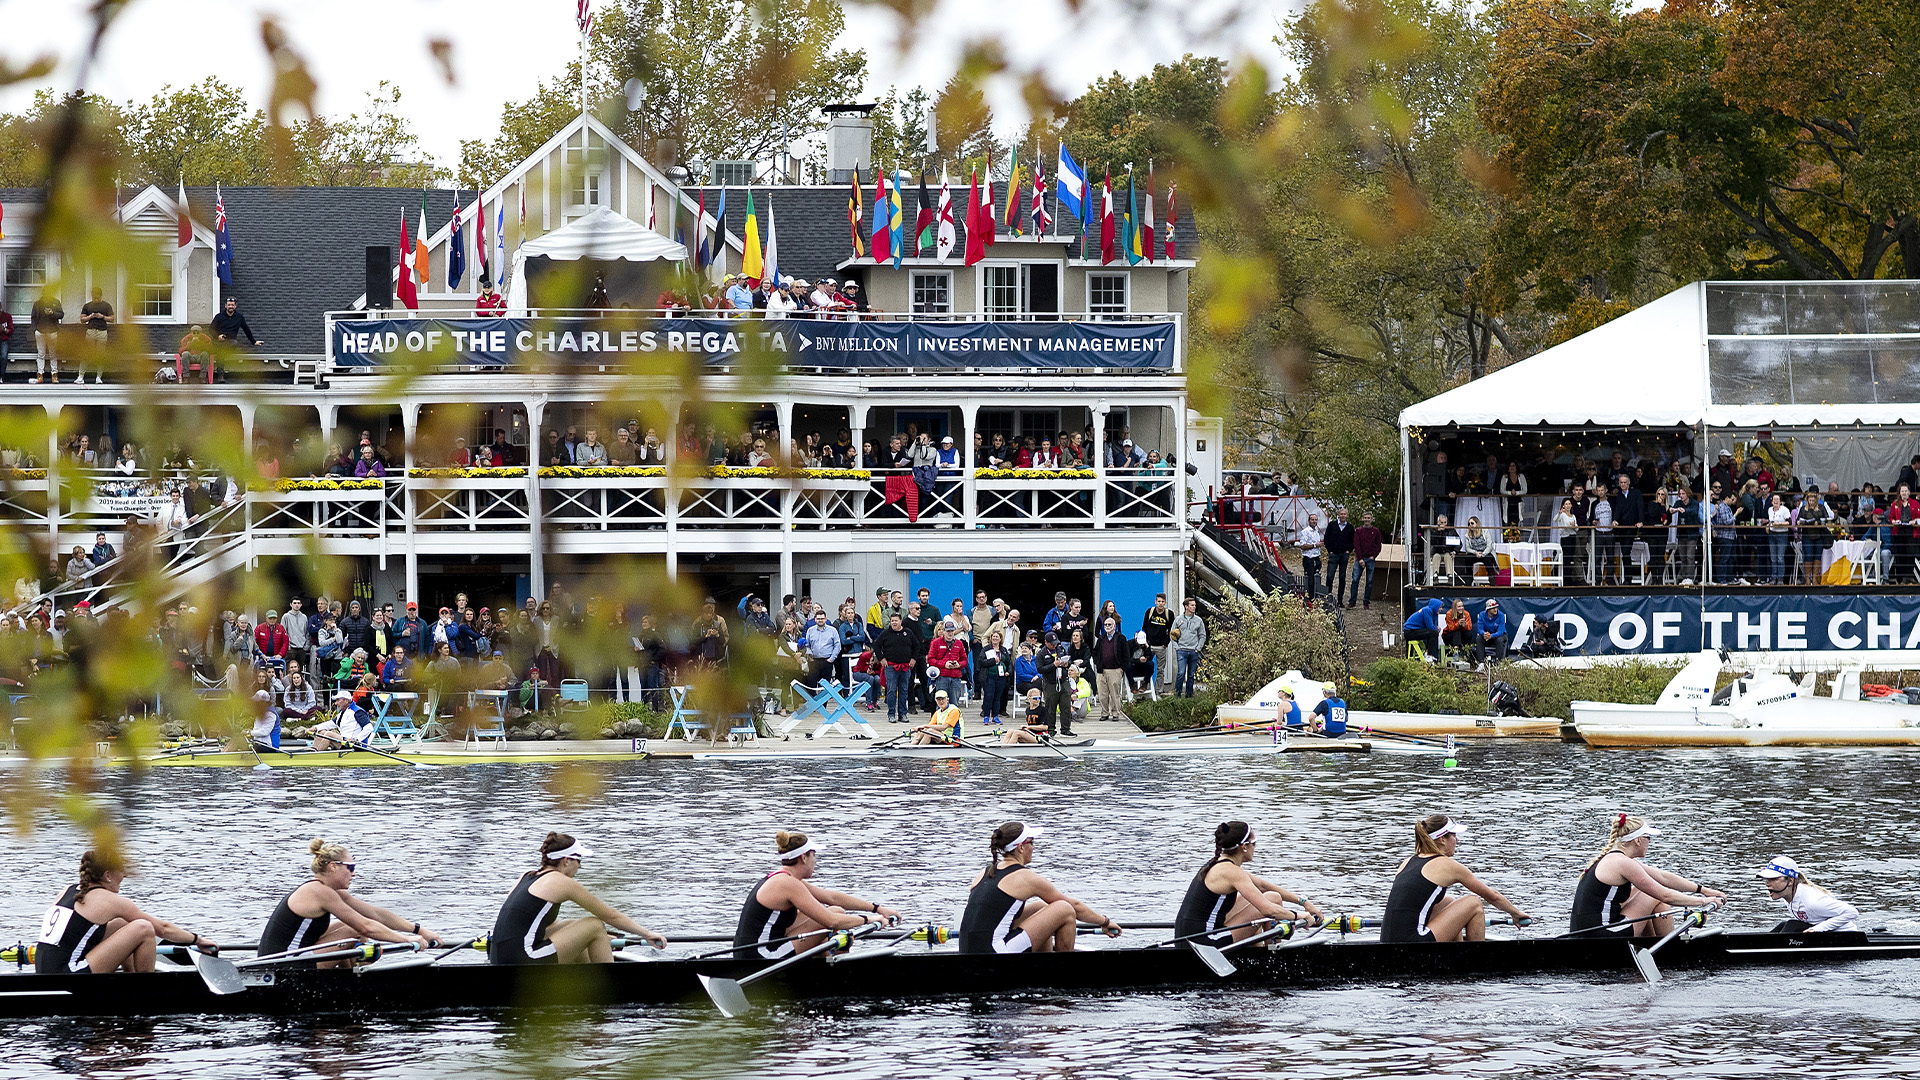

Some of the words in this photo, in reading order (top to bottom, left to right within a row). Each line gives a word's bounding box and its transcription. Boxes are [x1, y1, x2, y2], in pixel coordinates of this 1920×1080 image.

[342, 331, 399, 354] HEAD
[405, 331, 443, 352] OF
[451, 330, 506, 352] THE
[515, 330, 657, 352] CHARLES
[815, 336, 836, 351] BNY
[838, 336, 899, 352] MELLON
[918, 337, 1033, 352] INVESTMENT
[1038, 337, 1166, 352] MANAGEMENT
[1608, 612, 1682, 650] OF
[1701, 611, 1808, 649] THE
[1334, 708, 1344, 720] 39
[1277, 731, 1287, 742] 34
[98, 744, 108, 755] 17
[636, 740, 646, 750] 37
[45, 908, 60, 937] 9
